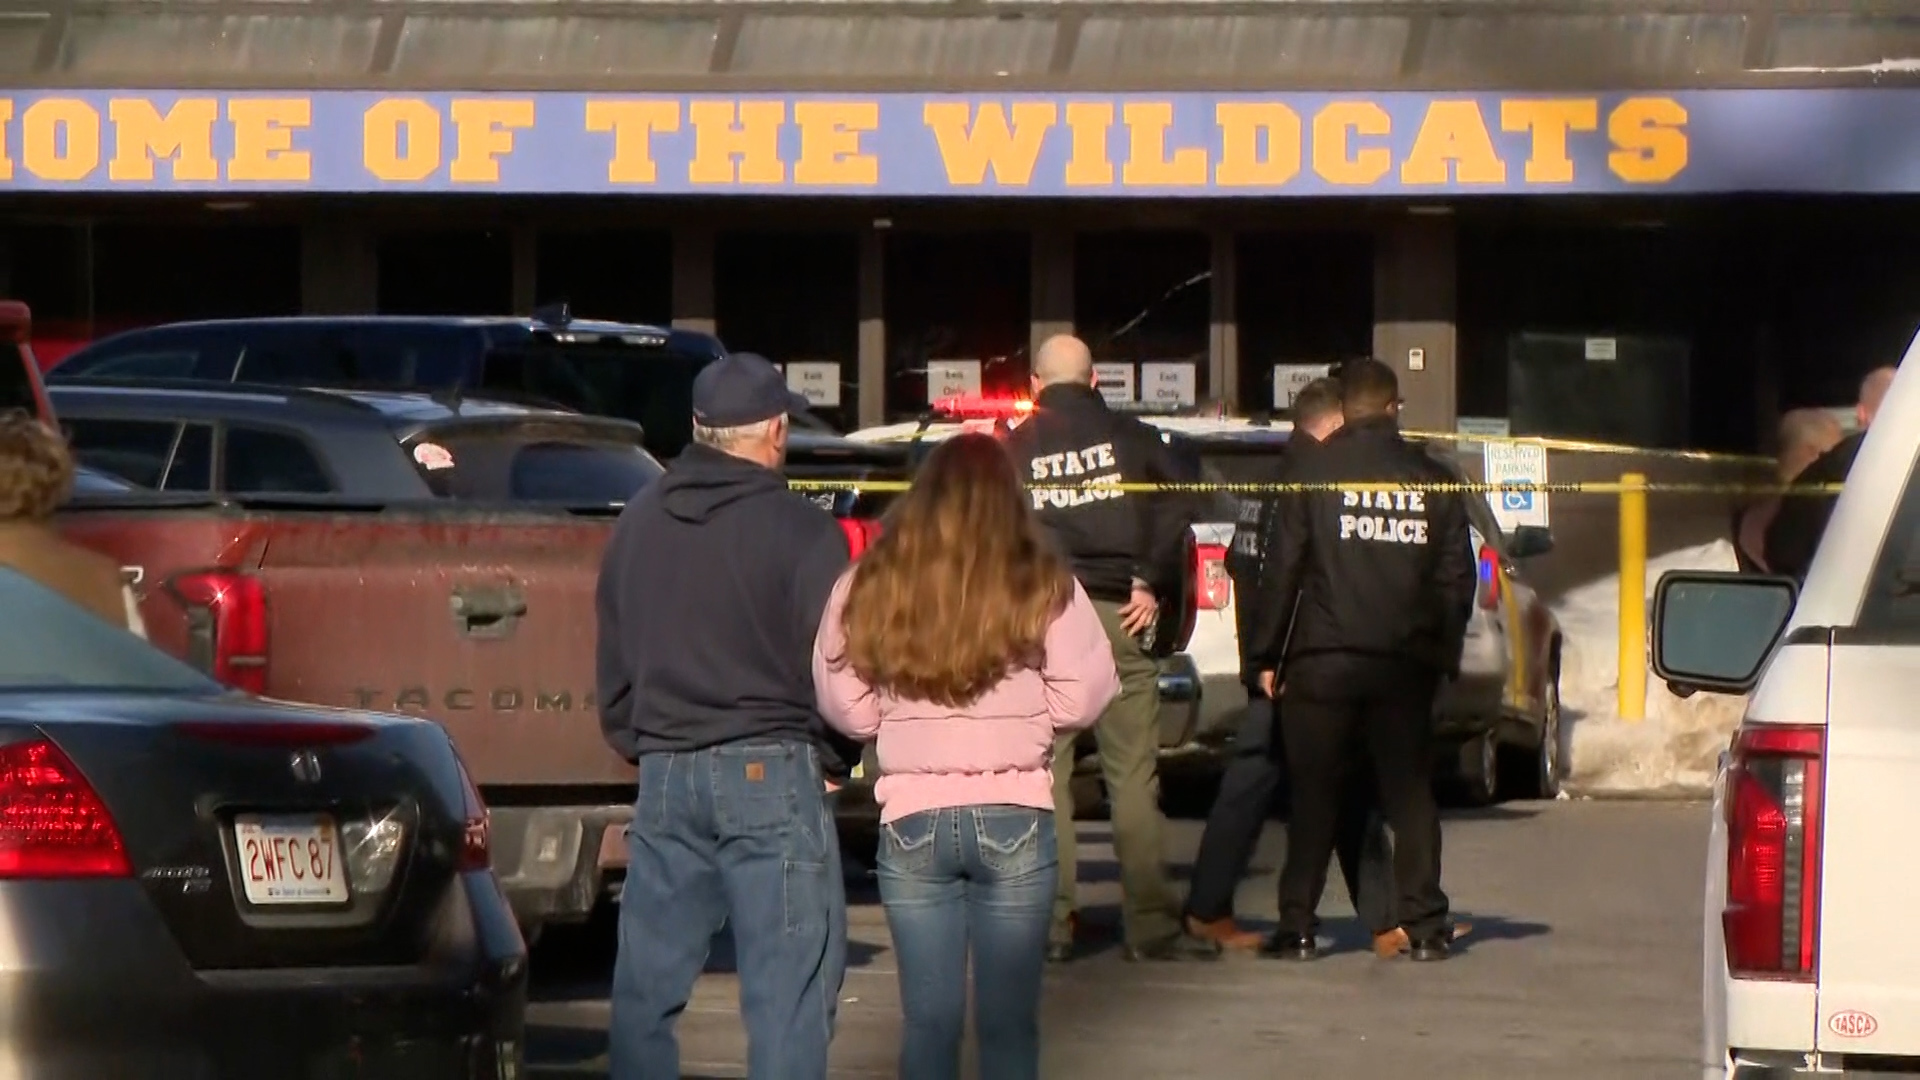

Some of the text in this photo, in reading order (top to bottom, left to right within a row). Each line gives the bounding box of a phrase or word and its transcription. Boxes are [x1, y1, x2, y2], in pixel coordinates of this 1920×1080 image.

[0, 98, 1688, 185] OME OF THE WILDCATS
[804, 371, 822, 380] Exit
[1160, 373, 1178, 381] Exit
[1156, 389, 1180, 400] Only
[1031, 443, 1115, 479] STATE
[1031, 473, 1124, 510] POLICE
[1343, 490, 1425, 511] STATE
[1340, 515, 1428, 544] POLICE
[1835, 1015, 1871, 1034] TASCA
